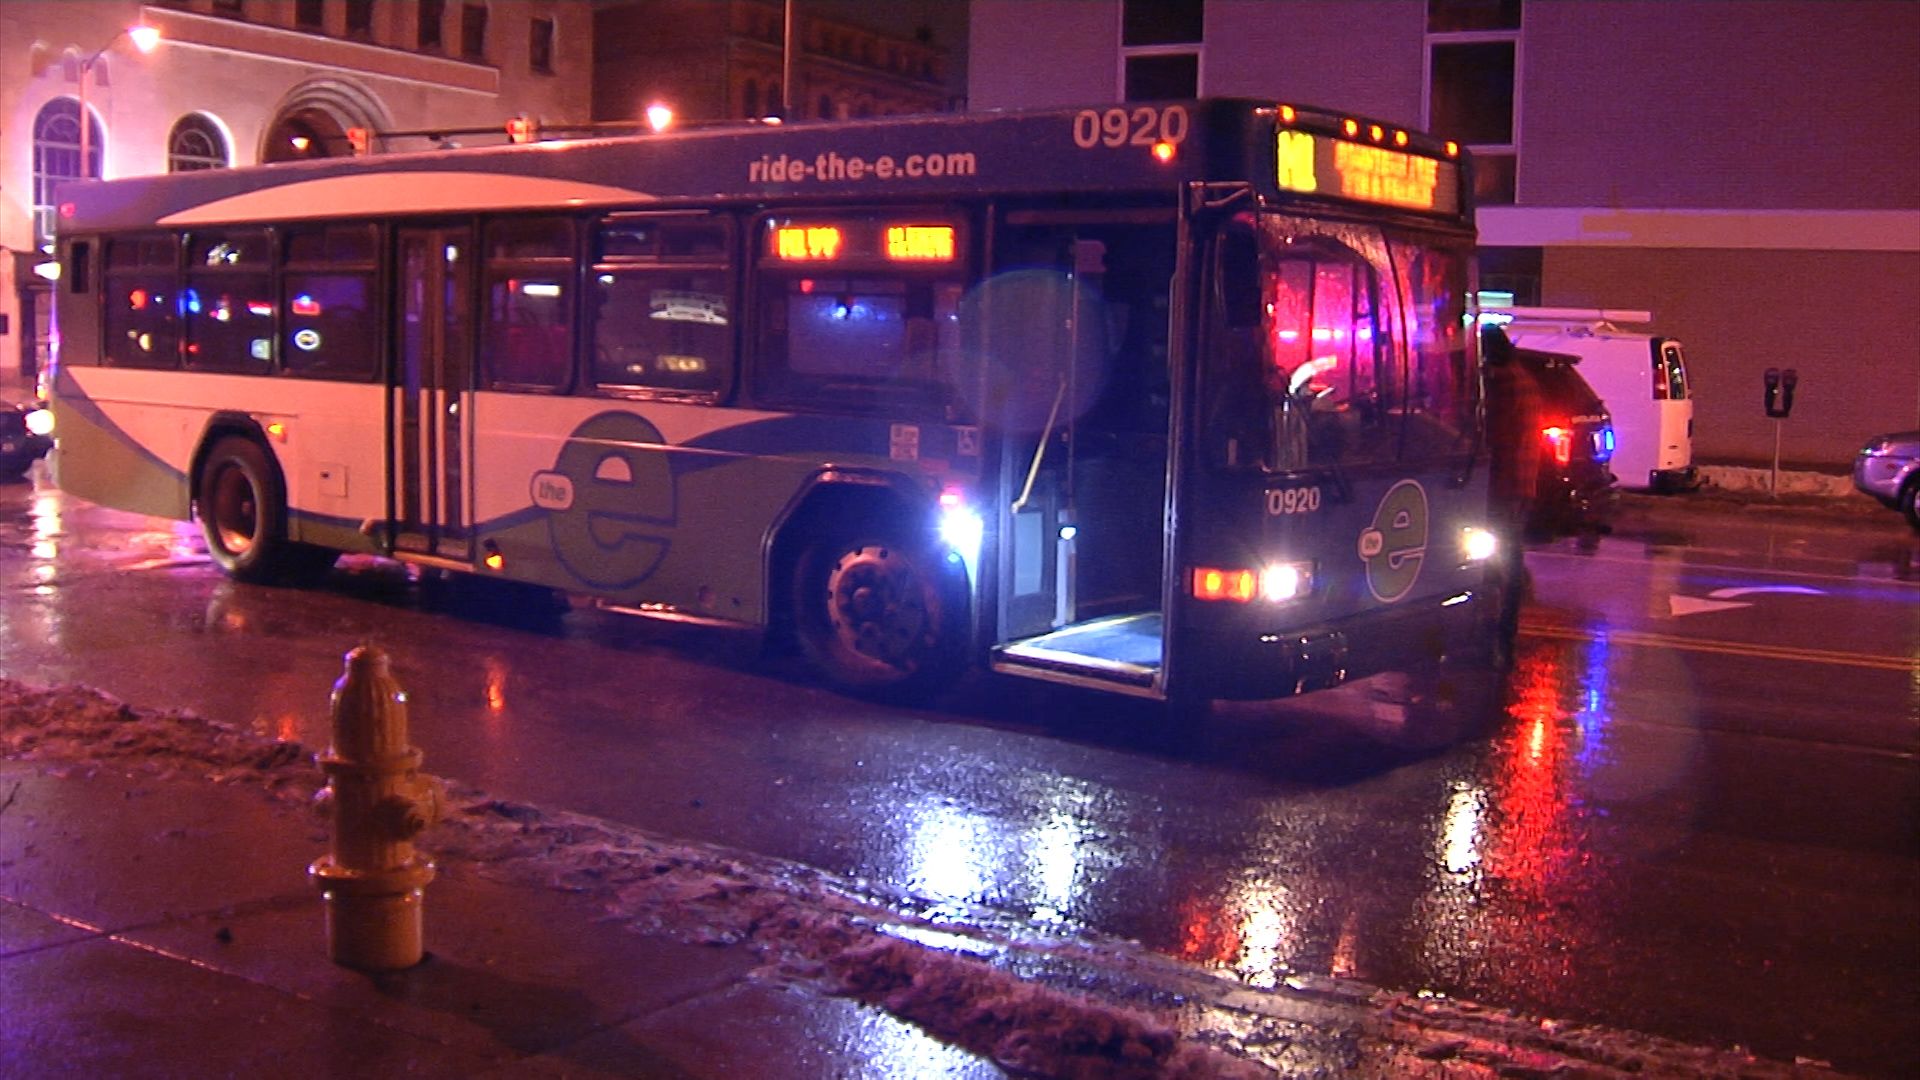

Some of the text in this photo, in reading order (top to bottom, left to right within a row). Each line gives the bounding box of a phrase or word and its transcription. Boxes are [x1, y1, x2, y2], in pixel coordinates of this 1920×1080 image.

[1074, 106, 1188, 148] 0920
[749, 152, 975, 182] ride-the-e.com
[1268, 487, 1321, 515] 0920
